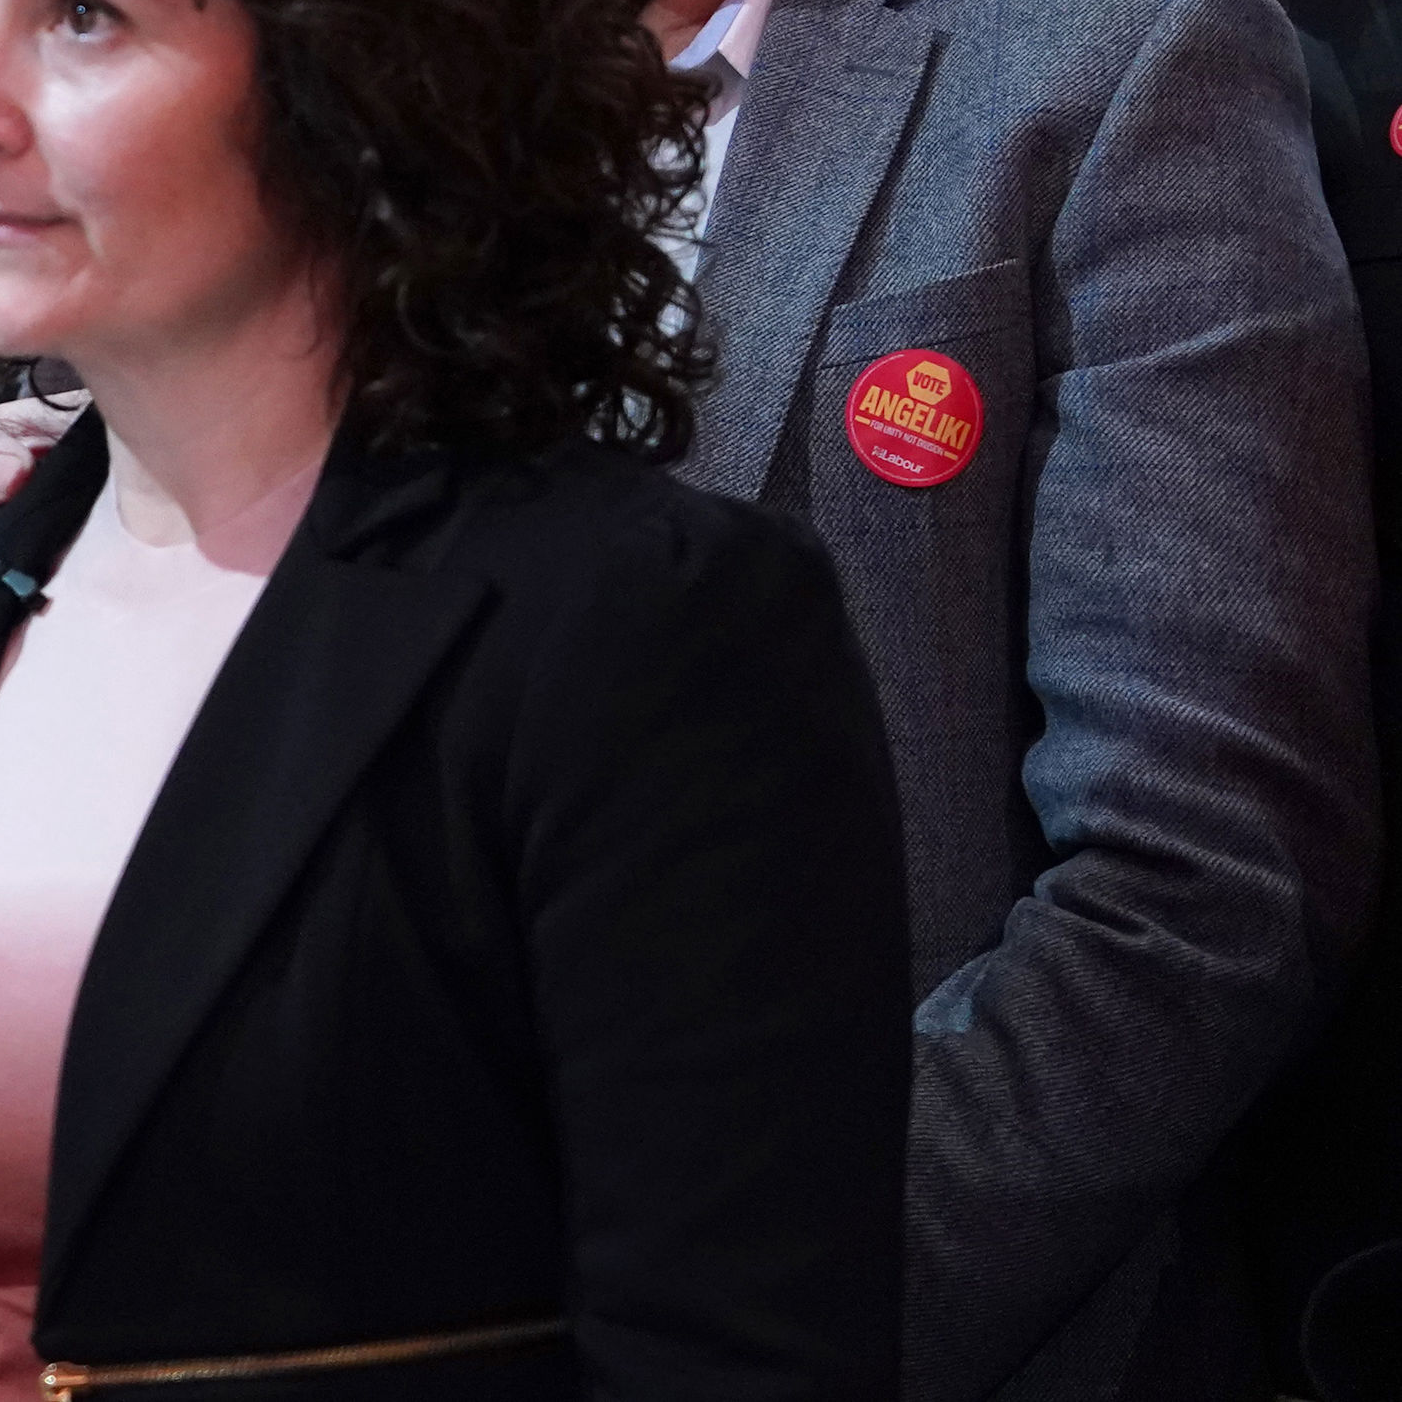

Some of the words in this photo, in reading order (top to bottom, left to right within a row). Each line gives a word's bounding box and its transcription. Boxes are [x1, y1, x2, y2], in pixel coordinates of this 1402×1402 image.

[912, 370, 948, 396] VOTE
[859, 385, 972, 450] ANGELIKI
[882, 449, 924, 473] Labour
